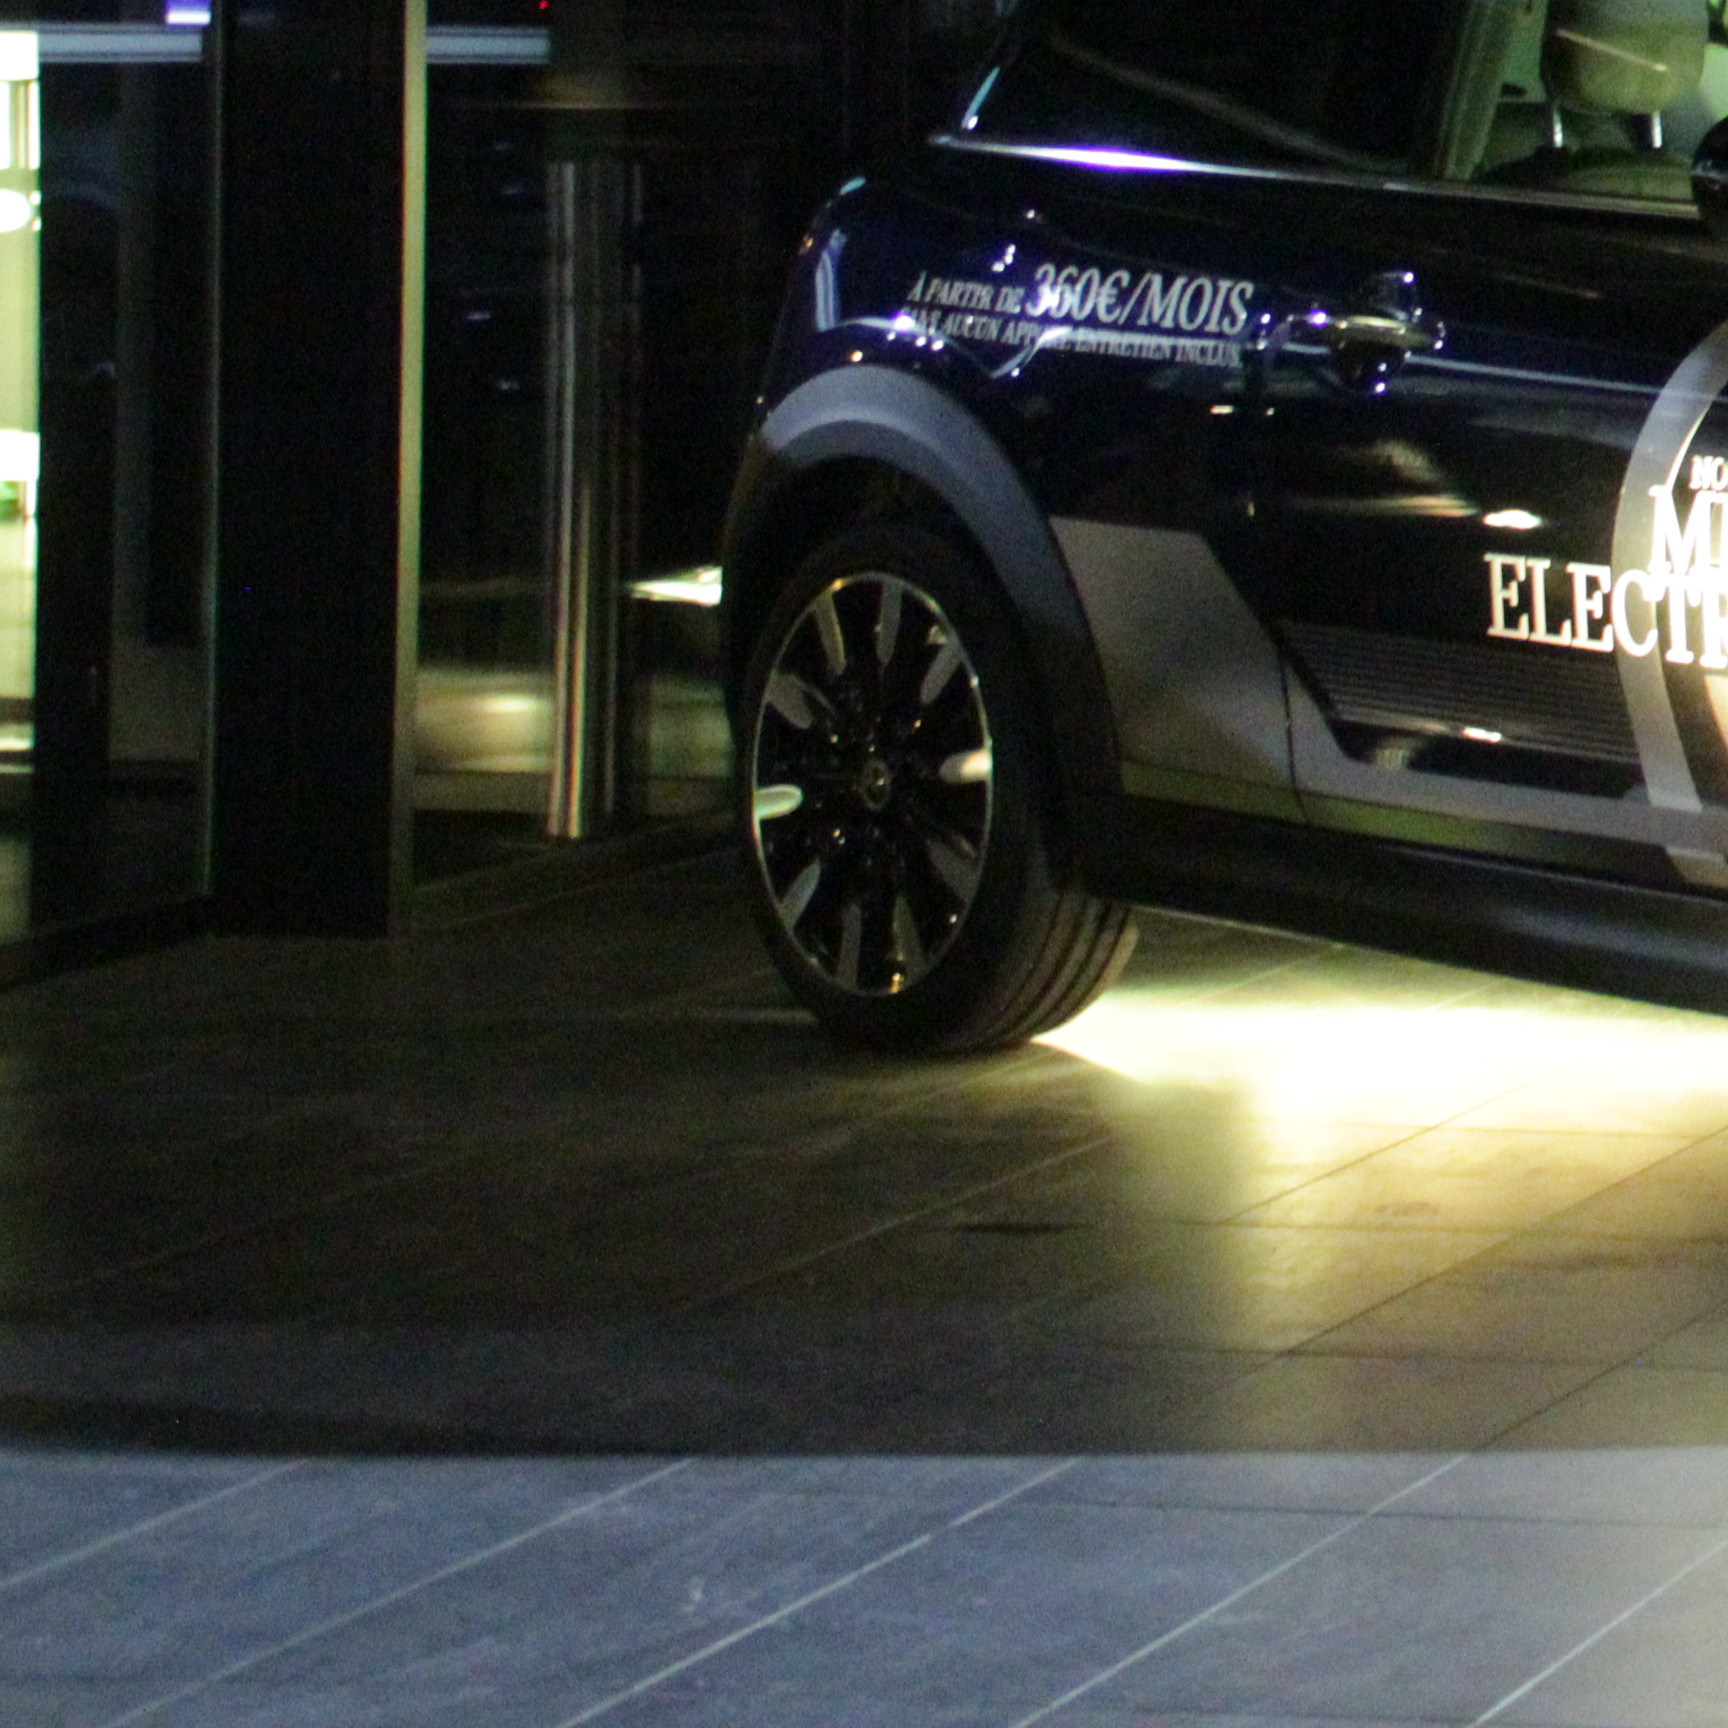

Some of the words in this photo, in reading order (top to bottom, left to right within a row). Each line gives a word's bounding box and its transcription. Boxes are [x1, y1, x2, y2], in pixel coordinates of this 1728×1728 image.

[924, 278, 995, 311] PARTIR
[994, 286, 1025, 314] DE
[1024, 262, 1255, 336] 360€/MOIS
